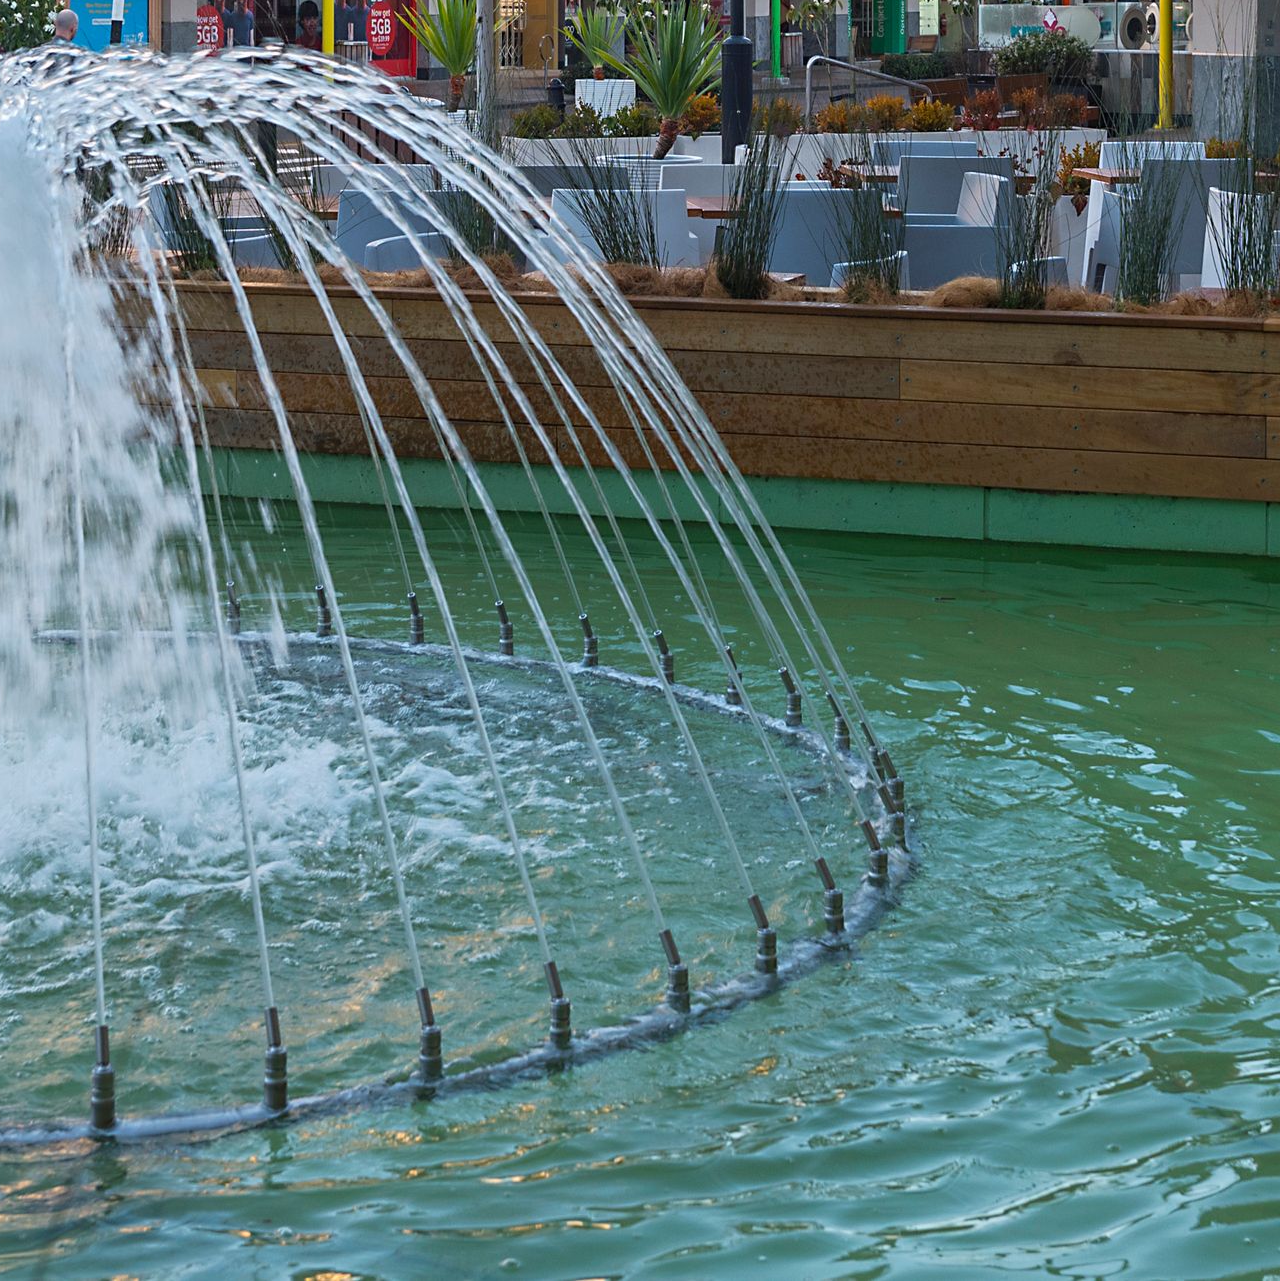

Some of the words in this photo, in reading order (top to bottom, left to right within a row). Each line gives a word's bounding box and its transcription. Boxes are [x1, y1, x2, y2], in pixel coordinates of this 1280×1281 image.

[371, 9, 381, 17] Now
[197, 25, 219, 43] 5GB
[371, 18, 391, 35] 5GB
